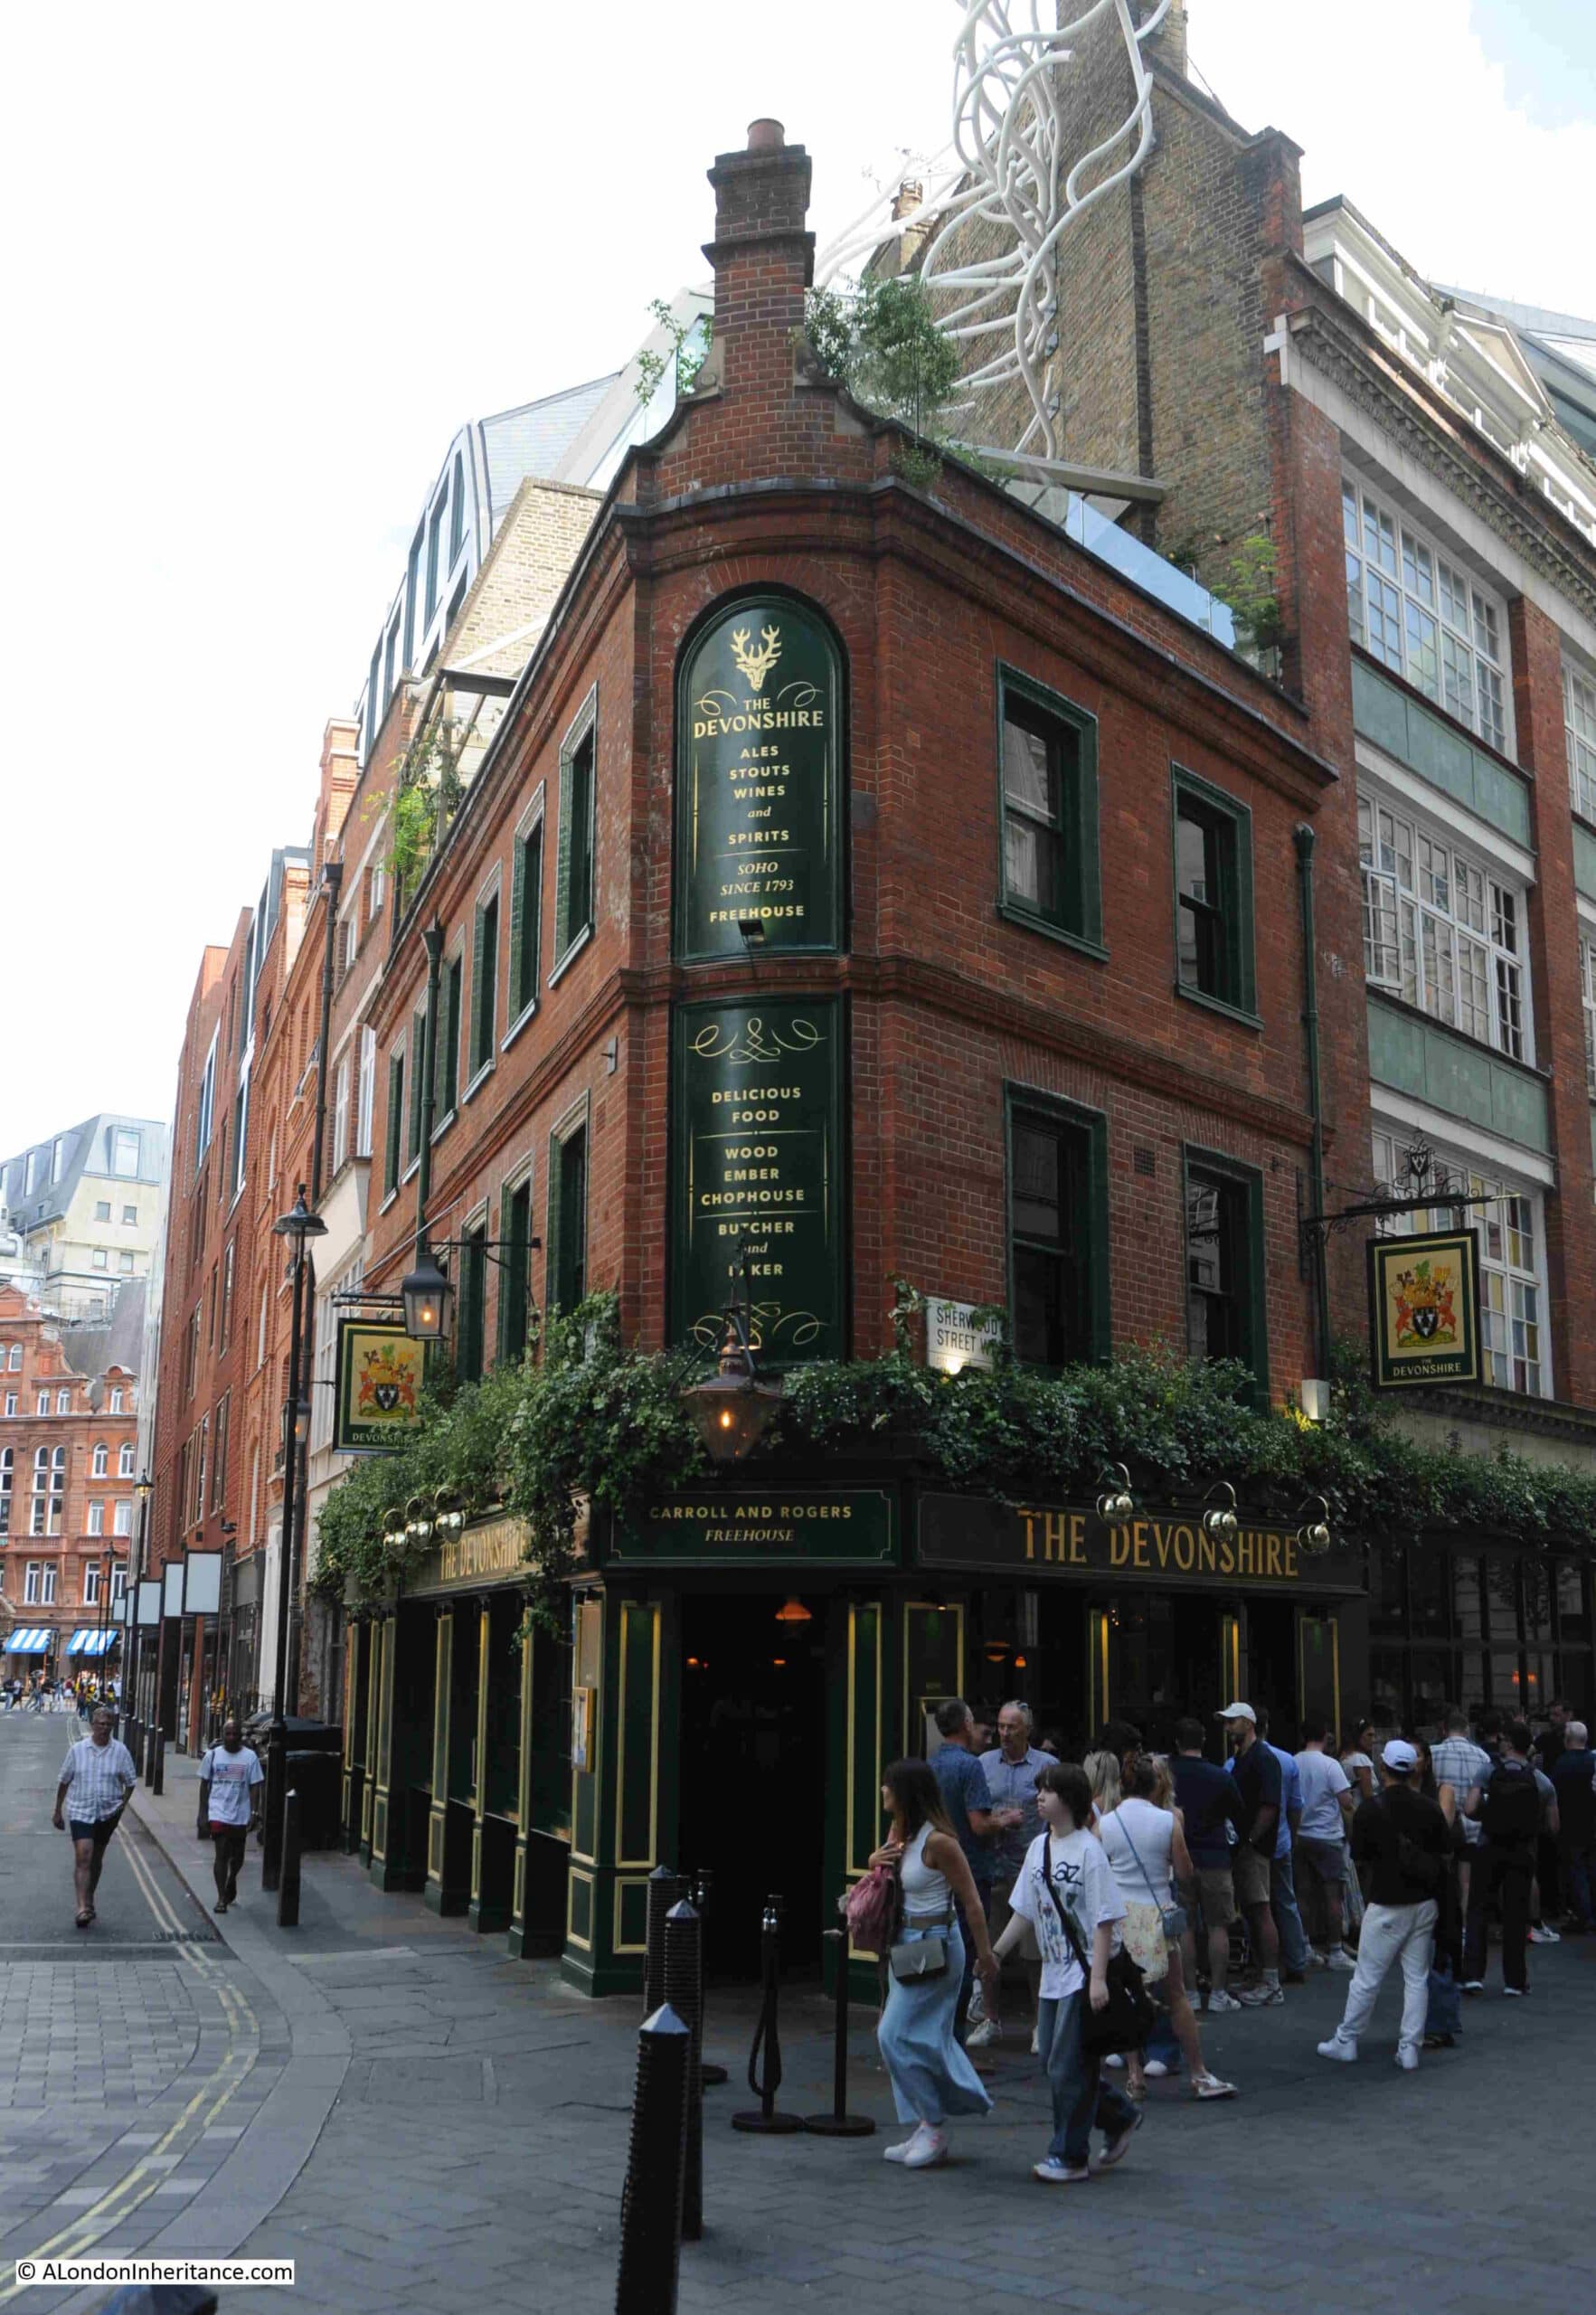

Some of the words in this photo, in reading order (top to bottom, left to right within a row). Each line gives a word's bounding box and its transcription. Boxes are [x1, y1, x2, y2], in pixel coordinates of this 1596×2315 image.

[743, 698, 770, 711] THE
[694, 711, 824, 739] DEVONSHIRE
[740, 746, 779, 759] ALES
[730, 765, 789, 780] STOUTS
[733, 785, 785, 799] WINES
[747, 807, 771, 818] and
[728, 830, 789, 845] SPIRITS
[737, 862, 778, 875] SOHO
[721, 882, 760, 896] SINCE
[765, 880, 794, 892] 1793
[710, 905, 804, 922] FREEHOUSE
[712, 1087, 801, 1103] DELICIOUS
[732, 1110, 779, 1123] FOOD
[725, 1146, 778, 1160] WOOD
[724, 1168, 779, 1182] EMBER
[702, 1189, 805, 1205] CHOPHOUSE
[728, 1263, 783, 1277] KER
[937, 1307, 997, 1336] SHERWOD
[937, 1328, 977, 1352] STREET
[980, 1337, 997, 1356] W
[1393, 1362, 1461, 1376] DEVONSHIRE
[353, 1432, 411, 1445] DEVONS
[650, 1506, 728, 1519] CARROLL
[735, 1506, 772, 1518] AND
[780, 1506, 853, 1518] ROGERS
[704, 1528, 795, 1542] FREEHOUSE
[1017, 1507, 1087, 1564] THE
[1110, 1521, 1299, 1577] DEVONSHIRE
[440, 1542, 456, 1581] THE
